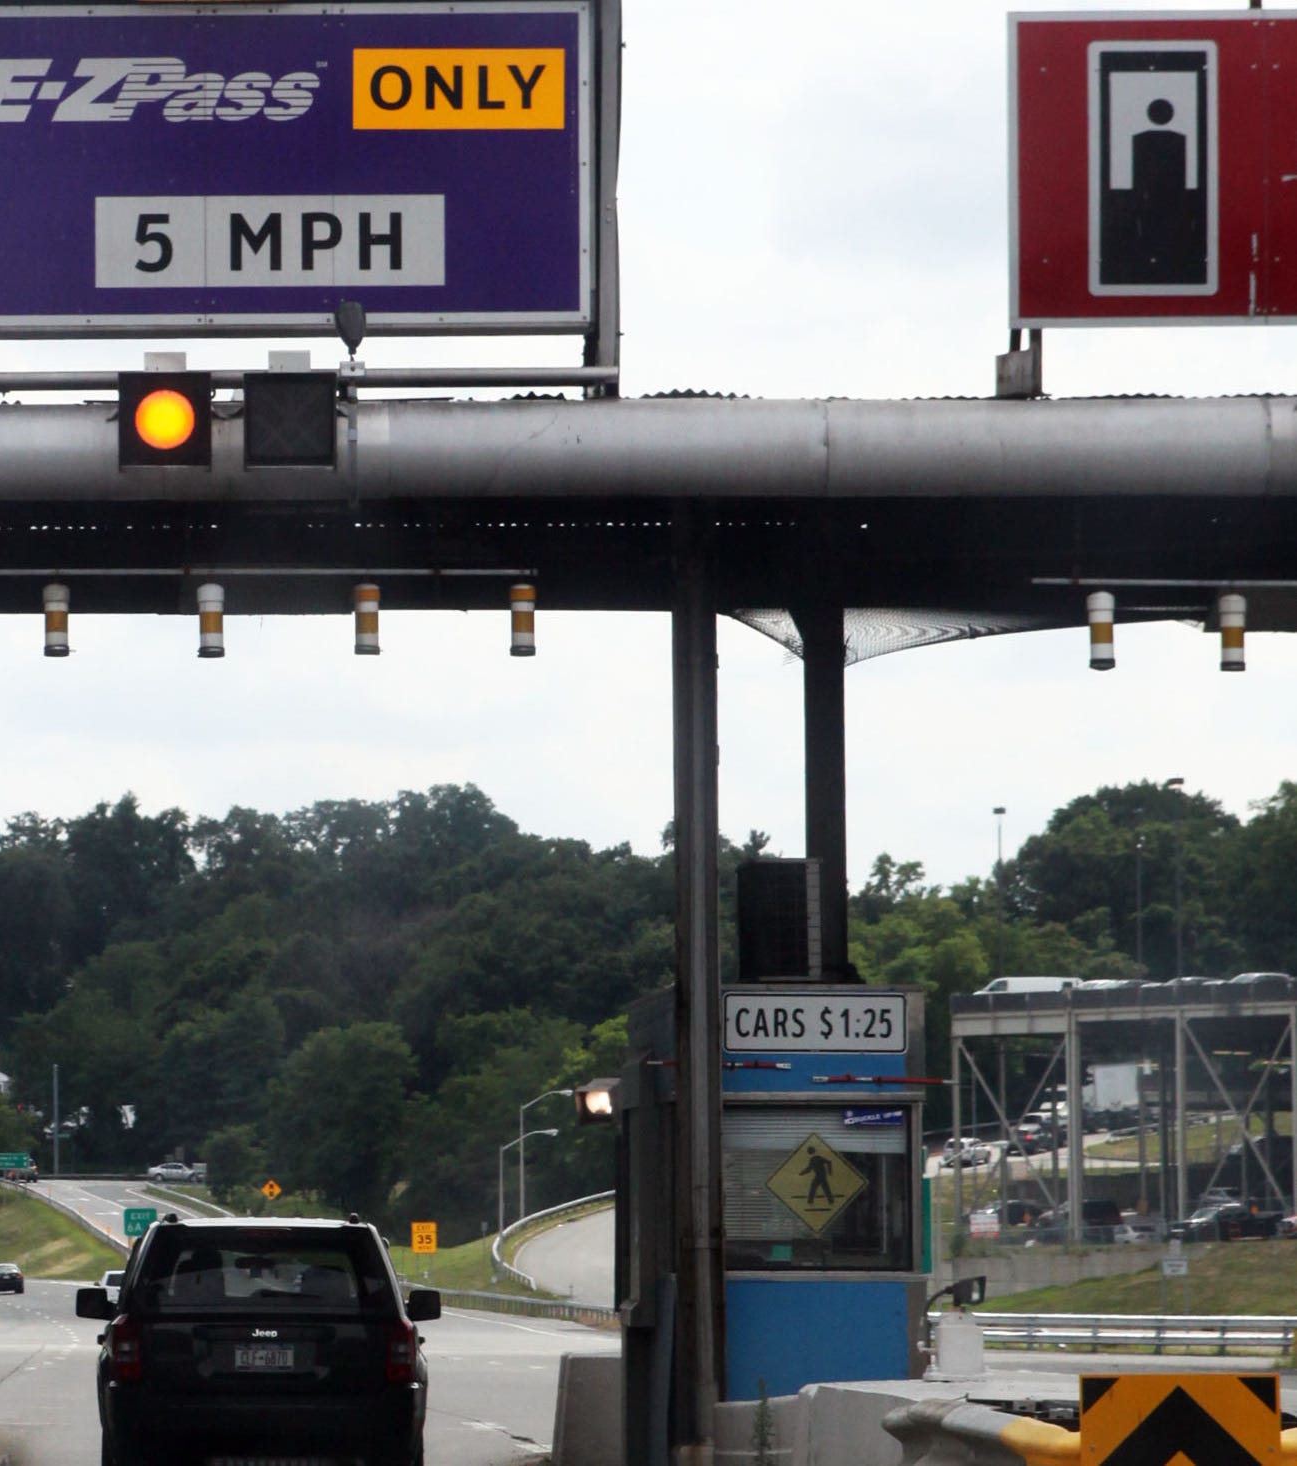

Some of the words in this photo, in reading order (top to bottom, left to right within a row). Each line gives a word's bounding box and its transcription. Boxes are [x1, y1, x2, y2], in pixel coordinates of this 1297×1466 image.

[370, 64, 546, 111] ONLY
[135, 213, 173, 273] 5
[230, 211, 402, 271] MPH
[735, 1008, 805, 1038] CARS
[417, 1234, 433, 1244] 35
[252, 1328, 278, 1338] Jeep
